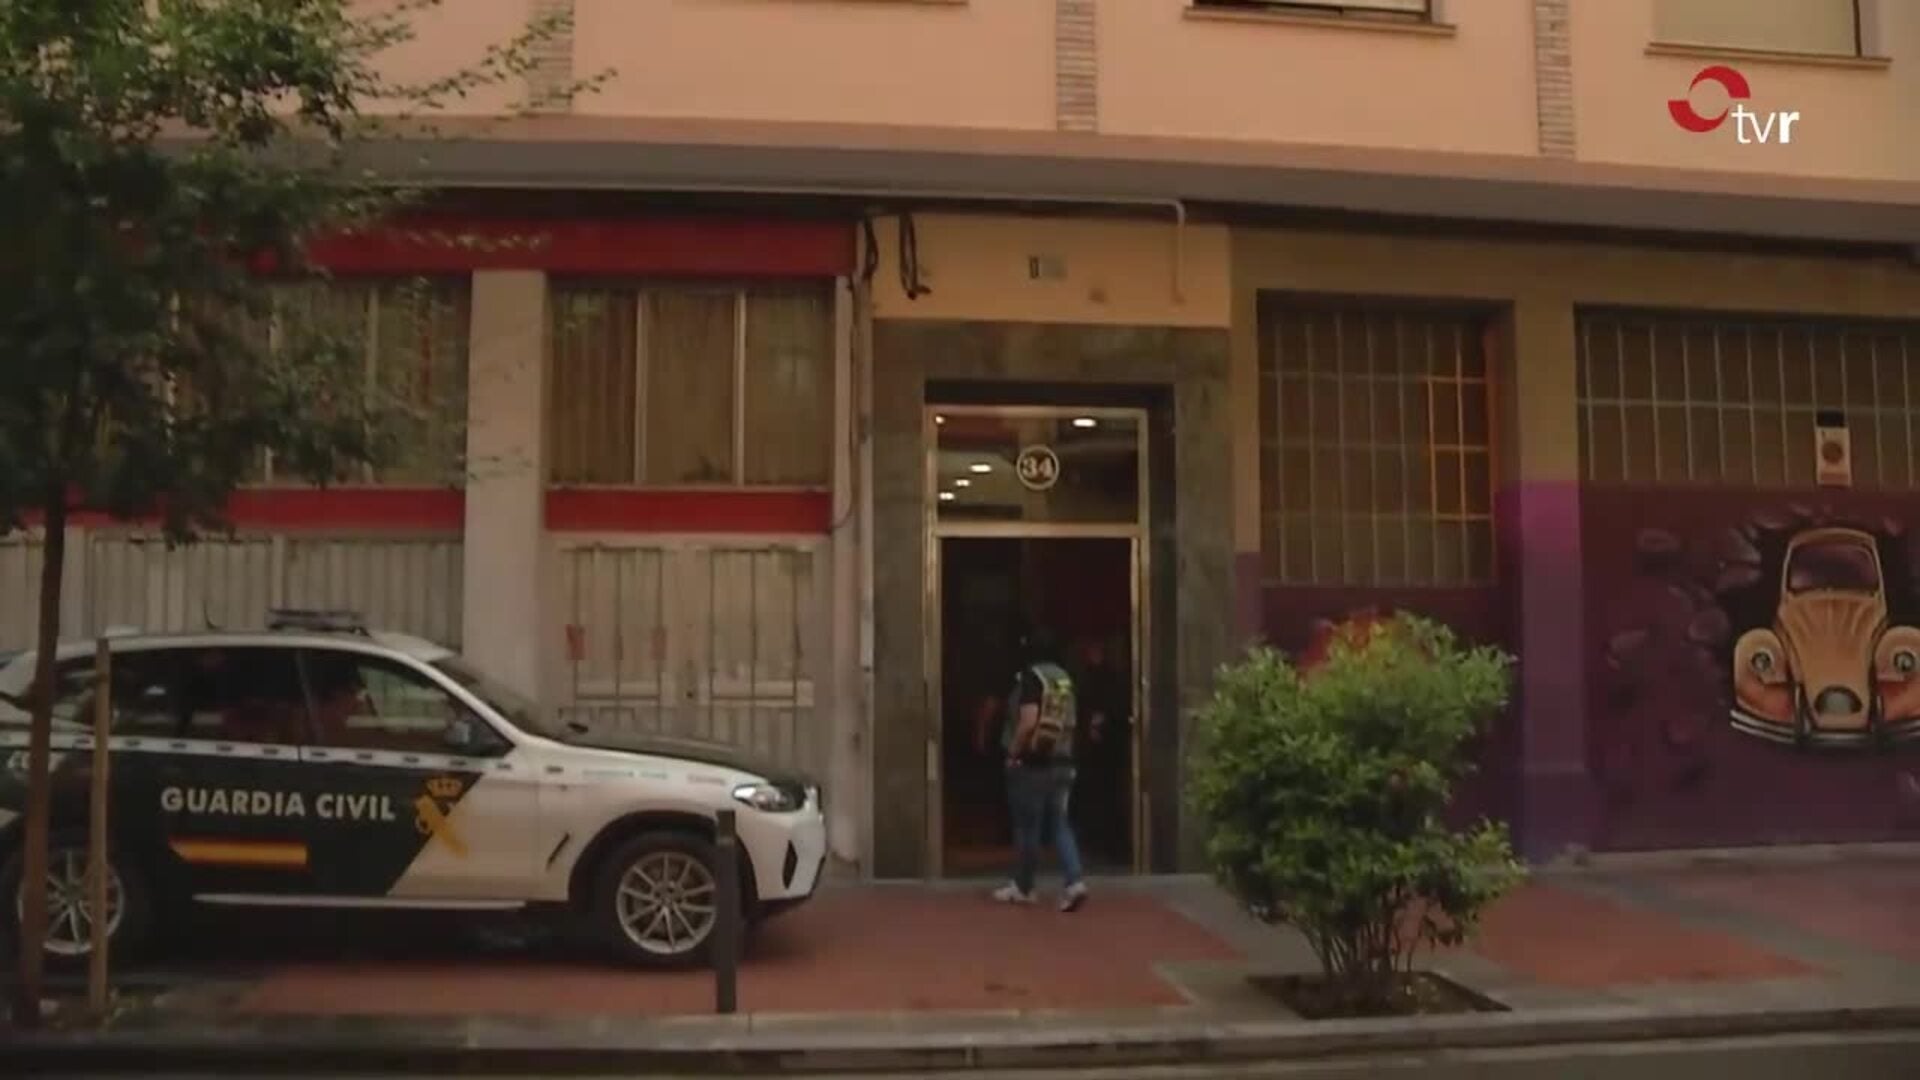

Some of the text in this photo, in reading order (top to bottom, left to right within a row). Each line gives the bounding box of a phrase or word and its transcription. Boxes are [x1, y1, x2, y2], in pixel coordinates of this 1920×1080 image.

[1022, 456, 1054, 479] 34
[161, 786, 396, 820] GUARDIA CIVIL
